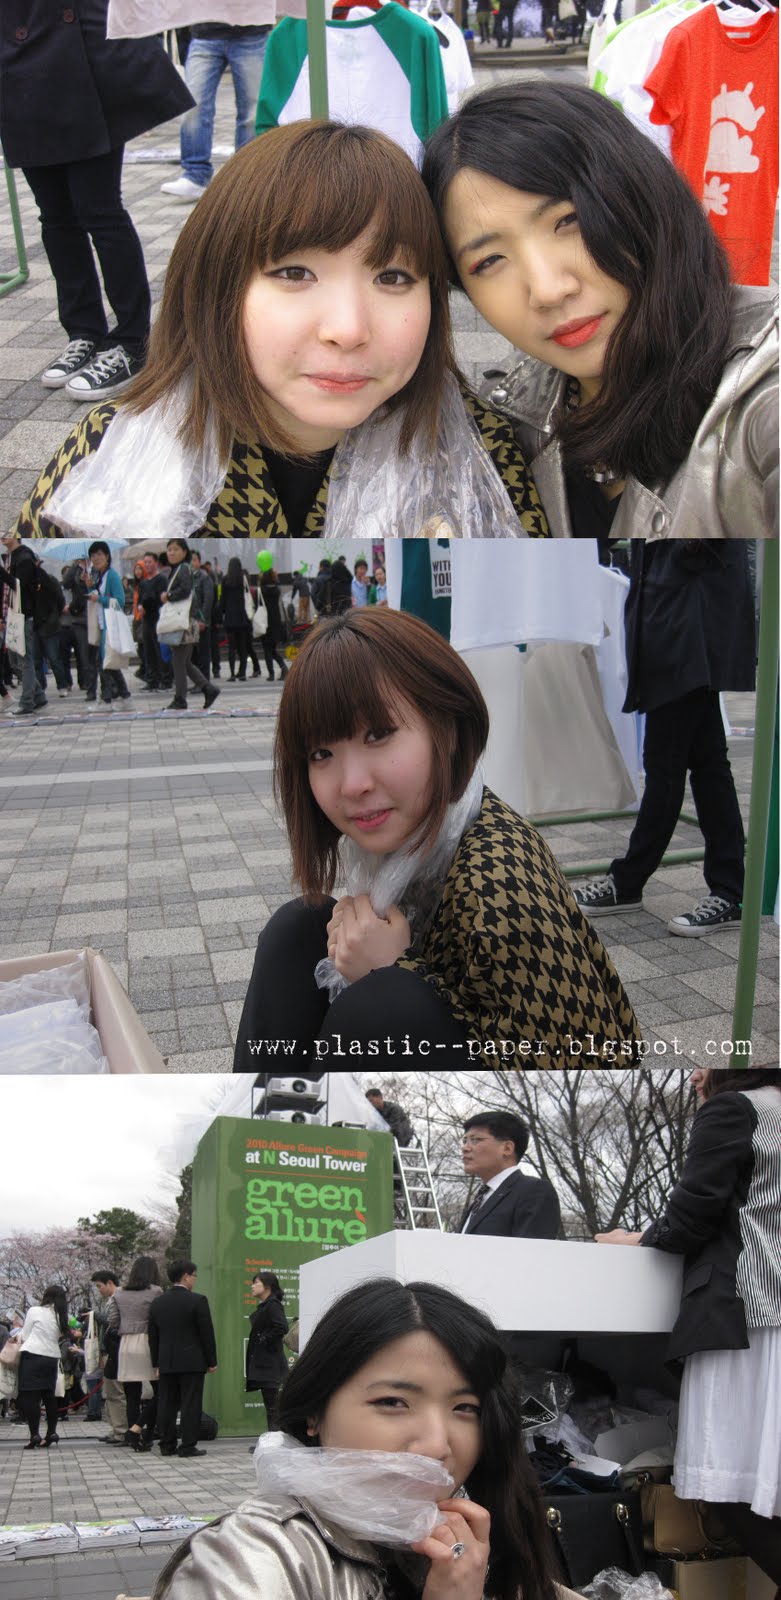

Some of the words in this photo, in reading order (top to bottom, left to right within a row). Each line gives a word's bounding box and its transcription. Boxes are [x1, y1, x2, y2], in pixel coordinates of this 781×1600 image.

[246, 1151, 260, 1164] at
[263, 1150, 276, 1165] N
[279, 1151, 320, 1169] Seoul
[322, 1155, 368, 1173] Tower
[245, 1178, 367, 1214] green
